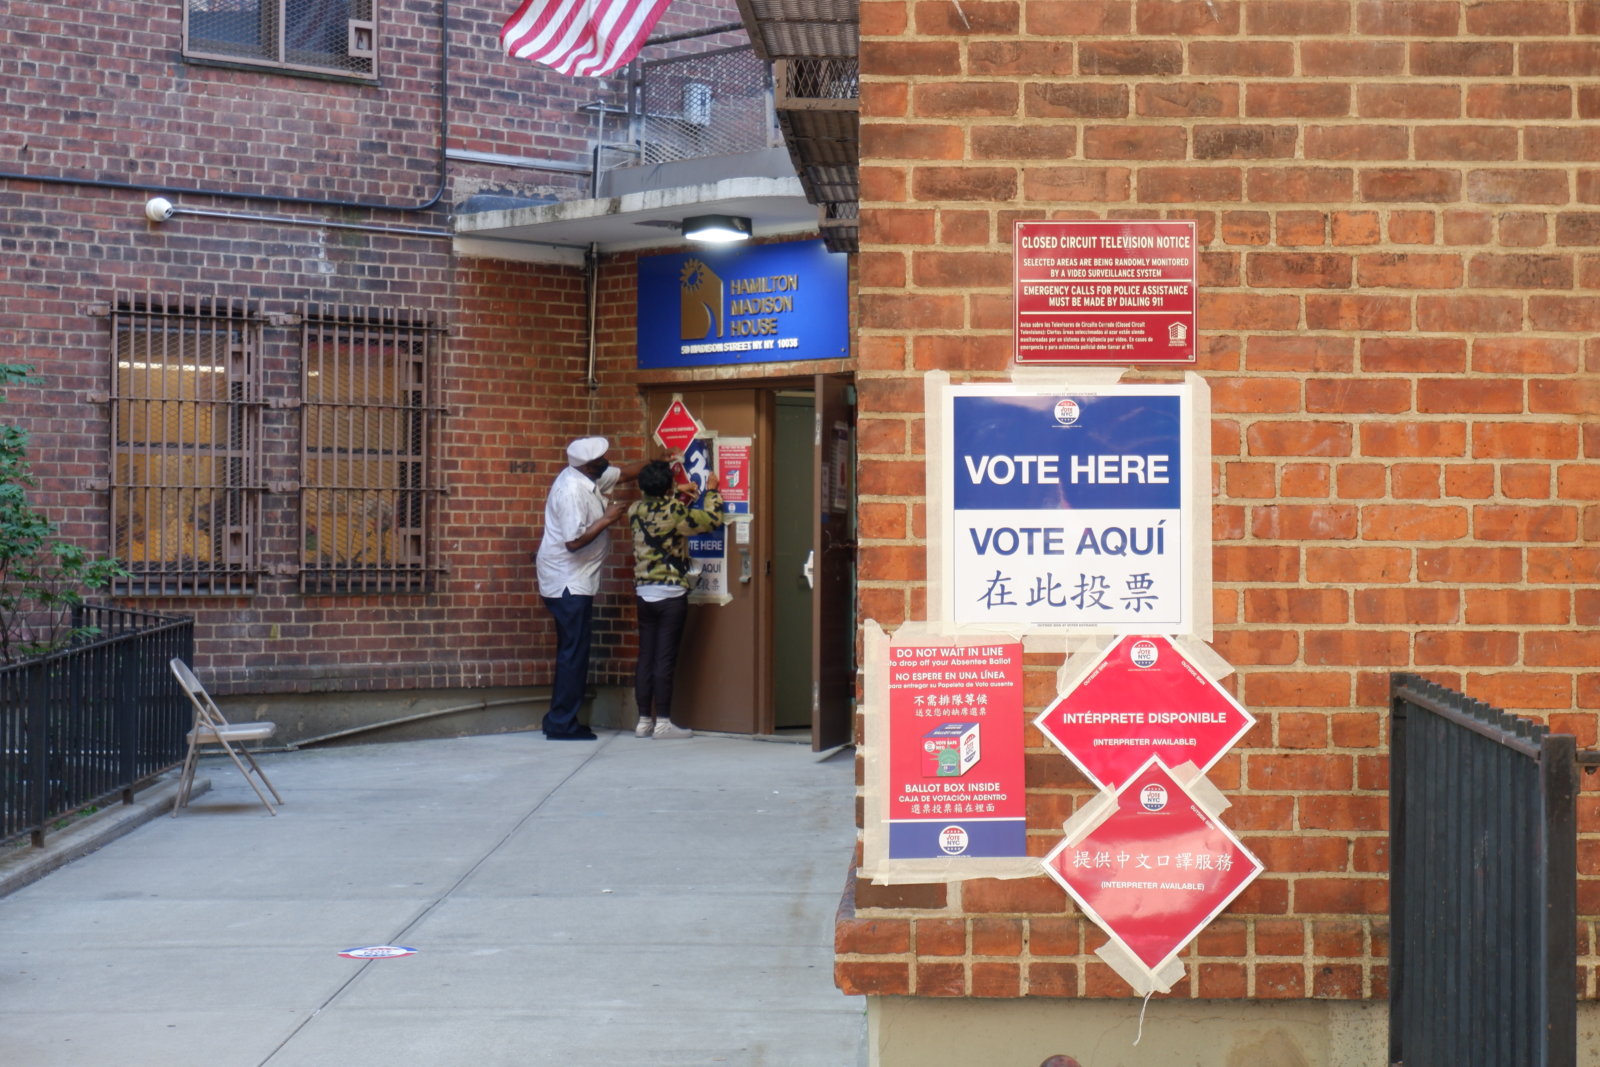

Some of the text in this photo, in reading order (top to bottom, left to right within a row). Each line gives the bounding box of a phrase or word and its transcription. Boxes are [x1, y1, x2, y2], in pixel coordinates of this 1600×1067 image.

[1022, 236, 1190, 248] CLOSED CIRCUIT TELEVISION NOTICE
[1023, 258, 1188, 266] SELECTED AREAS ARE BEING RANDOMLY MONITORED
[1050, 268, 1162, 278] BY A VIDEO SURVEILLANCE SYSTEM
[731, 275, 798, 294] HAMILTON
[1024, 286, 1188, 295] EMERGENCY CALLS FOR POLICE ASSISTANCE
[731, 296, 793, 316] MADISON
[1049, 297, 1164, 306] MUST BE MADE BY DIALING 911
[731, 318, 778, 337] HOUSE
[964, 455, 1169, 484] VOTE HERE
[969, 519, 1166, 557] VOTE AQUÍ
[700, 540, 723, 550] HERE
[977, 570, 1159, 613] 在此投票
[896, 647, 1003, 657] DO NOT WAIT IN LINE
[912, 672, 942, 680] ESPERE
[959, 672, 978, 680] UNA
[980, 669, 1005, 679] LÍNEA
[1063, 710, 1226, 724] INTÉRPRETE DISPONIBLE
[905, 782, 1000, 793] BALLOT BOX INSIDE
[932, 793, 970, 802] VOTACIÓN
[1072, 850, 1234, 872] 提供中文口譯服務
[1101, 881, 1204, 891] (INTERPRETER AVAILABLE)
